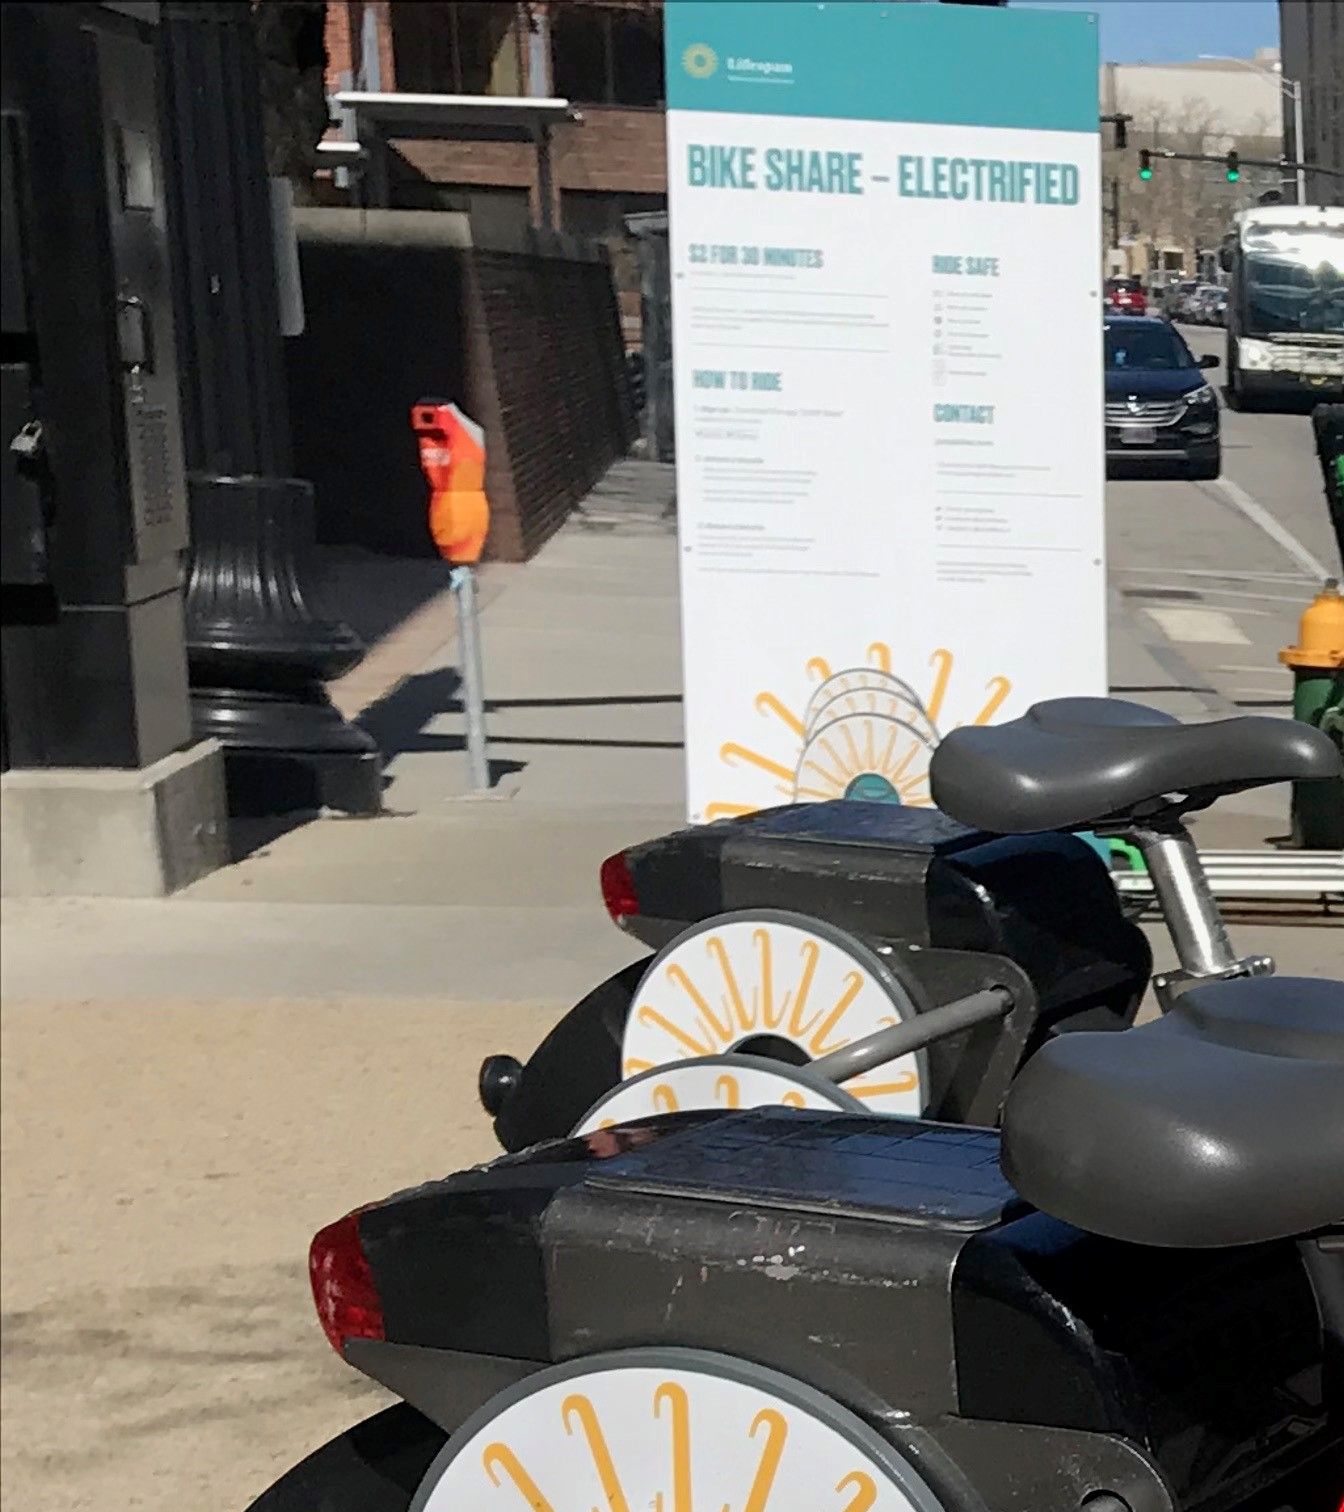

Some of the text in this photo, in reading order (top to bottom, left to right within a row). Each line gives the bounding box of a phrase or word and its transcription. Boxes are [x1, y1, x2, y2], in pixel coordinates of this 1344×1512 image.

[687, 143, 757, 190] BIKE
[765, 146, 865, 195] SHARE
[898, 154, 1081, 206] ELECTRIFIED
[710, 244, 739, 265] FOR
[762, 246, 825, 268] MINUTES
[932, 254, 1000, 277] RIDE SAFE
[692, 369, 726, 390] HOW
[751, 371, 783, 392] RIDE
[933, 403, 994, 424] CONTACT
